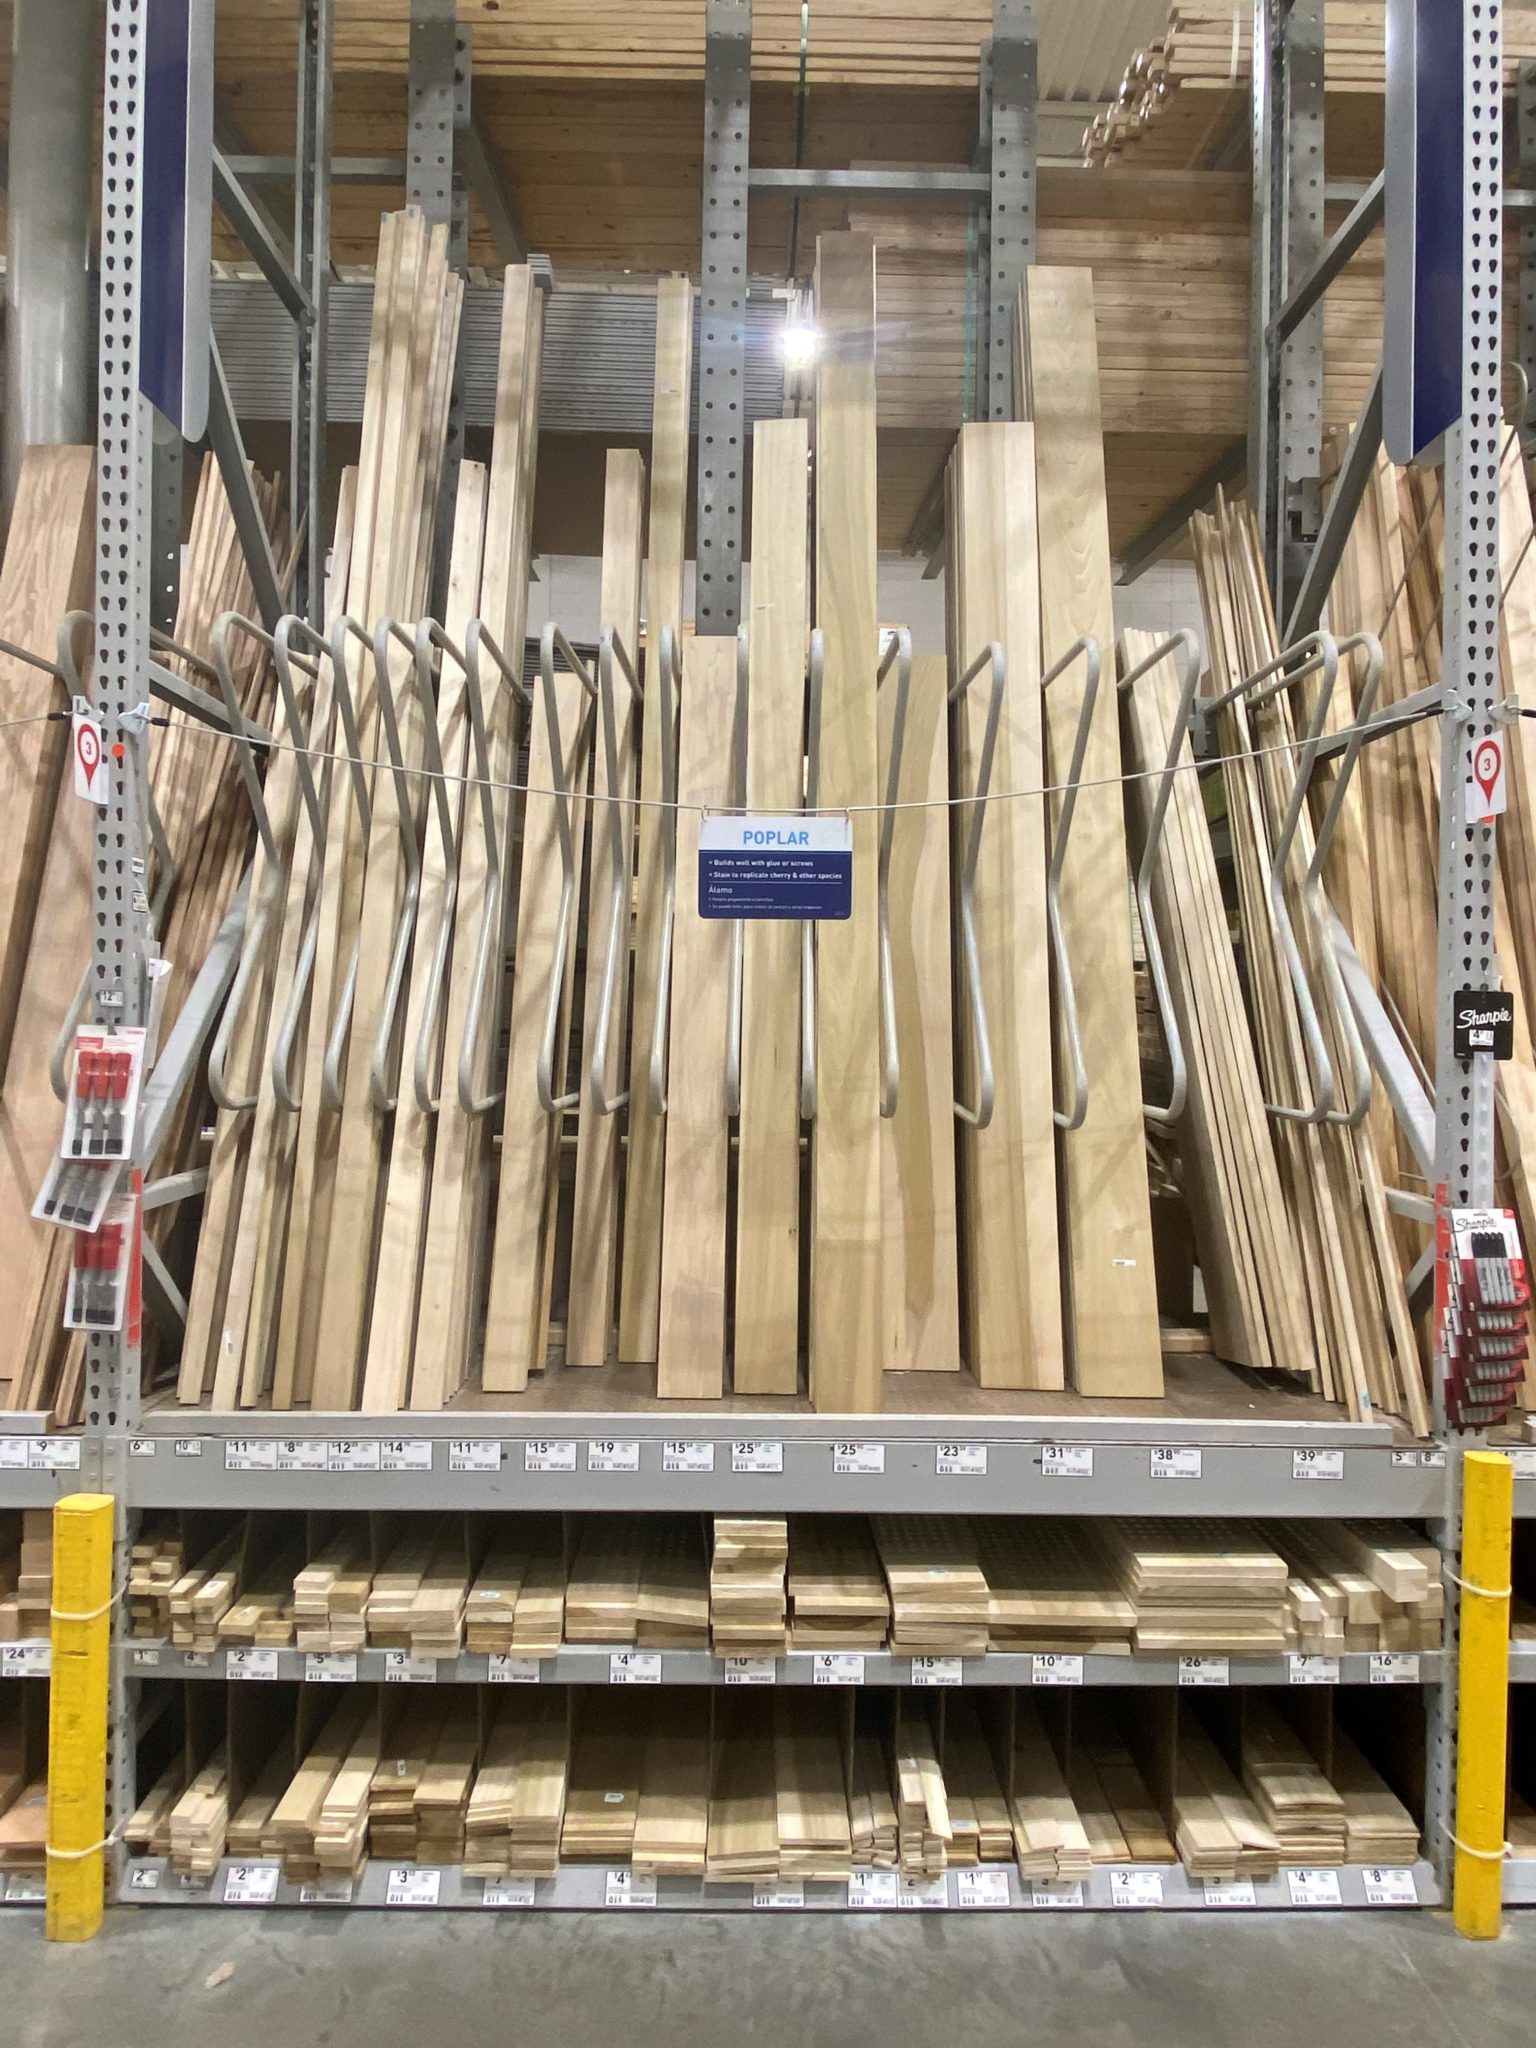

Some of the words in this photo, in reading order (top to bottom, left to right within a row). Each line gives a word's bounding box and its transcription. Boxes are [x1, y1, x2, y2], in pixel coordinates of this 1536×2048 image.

[85, 741, 92, 756] 3
[1483, 758, 1491, 771] 3
[743, 830, 809, 845] POPLAR
[714, 859, 734, 867] Builds
[735, 859, 750, 867] well
[751, 859, 765, 867] with
[766, 859, 782, 868] glue
[740, 872, 769, 880] replicate
[770, 872, 791, 880] cherry
[818, 873, 842, 881] species
[708, 886, 733, 894] Álamo
[1456, 1007, 1512, 1028] Sharpie
